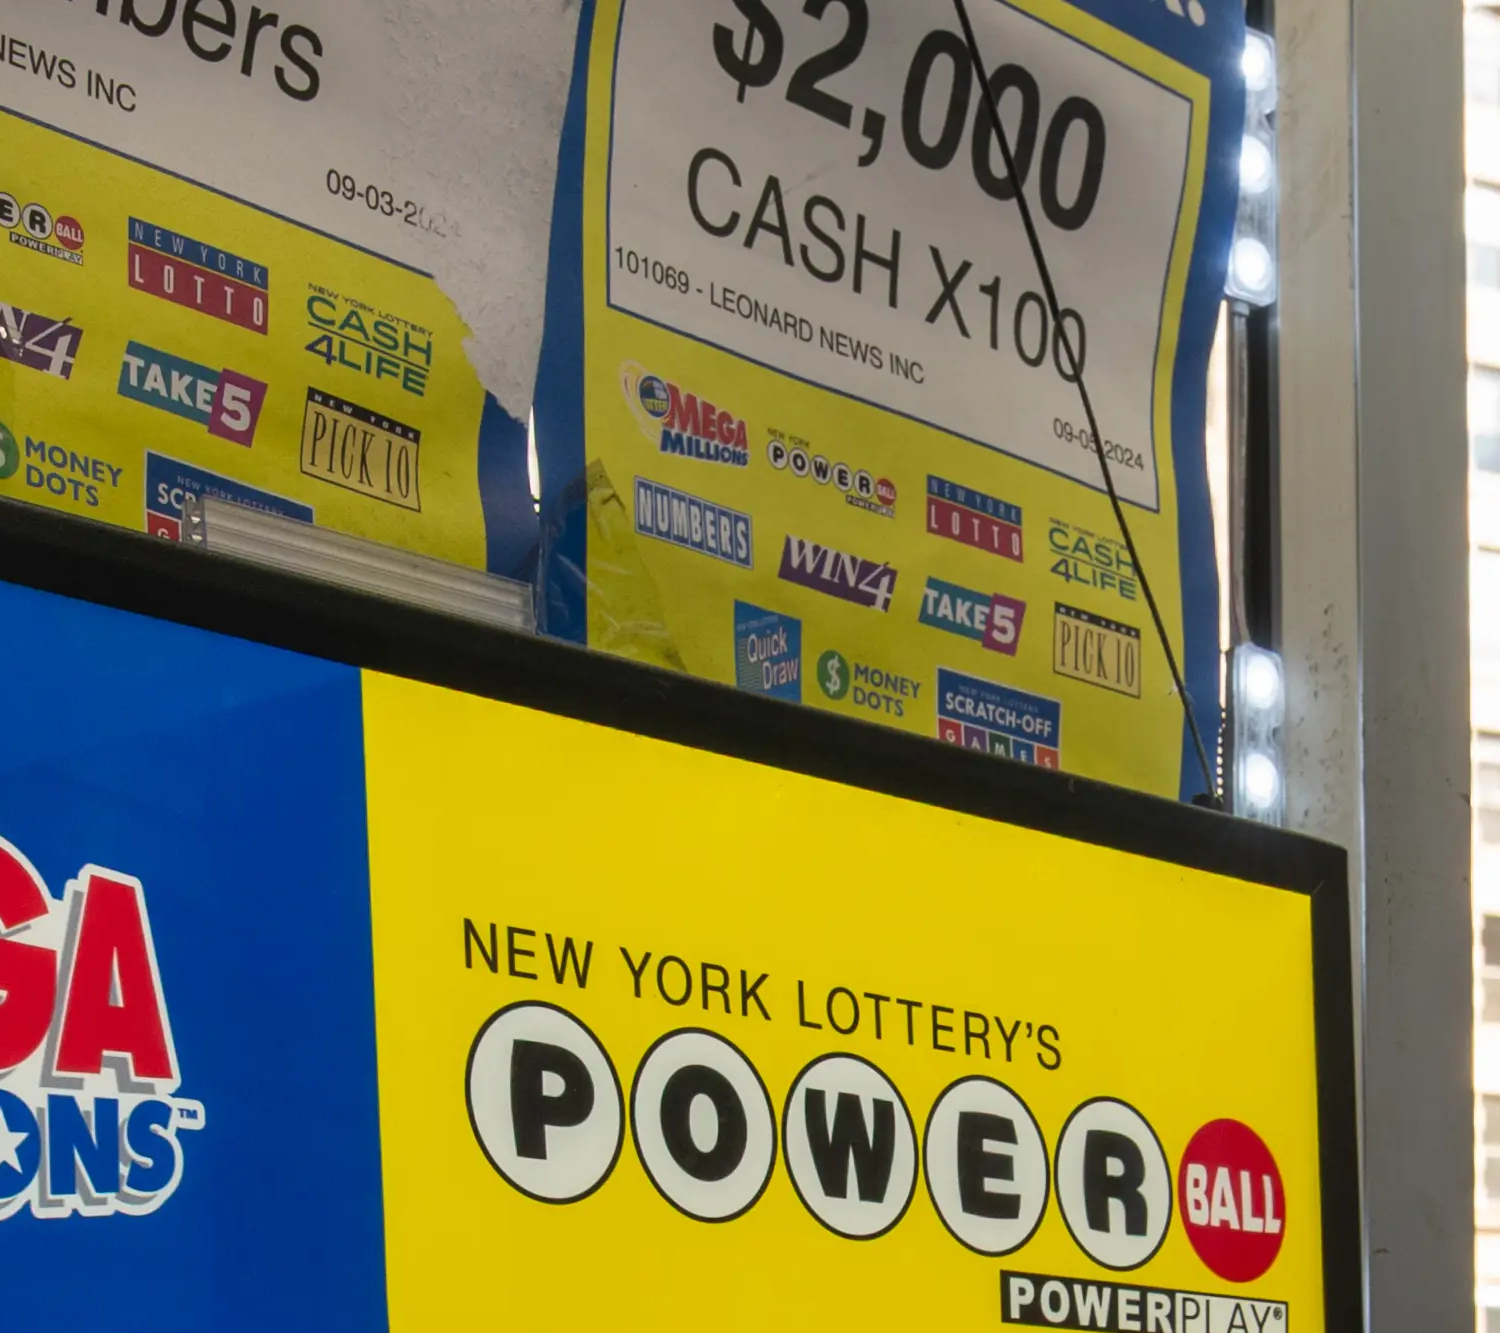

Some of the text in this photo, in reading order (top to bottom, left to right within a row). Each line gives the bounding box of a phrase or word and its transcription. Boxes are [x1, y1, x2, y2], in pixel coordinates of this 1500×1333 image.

[87, 69, 137, 113] INC
[711, 0, 1107, 232] $2,000
[133, 221, 262, 284] NEW YORK
[687, 147, 1087, 383] CASH X100
[133, 254, 264, 327] LOTTO
[307, 283, 435, 338] NEW YORK LOTTERY
[614, 246, 926, 385] 101069 LEONARD NEWS INC
[306, 295, 432, 367] CASH
[304, 333, 428, 398] 4LIFE
[665, 382, 748, 451] MEGA
[25, 436, 123, 488] MONEY
[312, 411, 410, 499] PICK 10
[660, 430, 749, 467] MILLIONS
[25, 463, 100, 507] DOTS
[930, 477, 1018, 523] NEW YORK
[638, 485, 749, 561] NUMBERS
[930, 504, 1020, 557] LOTTO
[1048, 527, 1138, 577] CASH
[747, 626, 788, 662] Quick
[1059, 620, 1136, 688] PICK 10
[762, 658, 798, 691] Draw
[853, 661, 920, 699] MONEY
[853, 686, 905, 717] DOTS
[945, 692, 1052, 738] SCRATCH-OFF
[945, 728, 1052, 768] GAMES
[462, 918, 1063, 1072] NEW YORK LOTTERY'S
